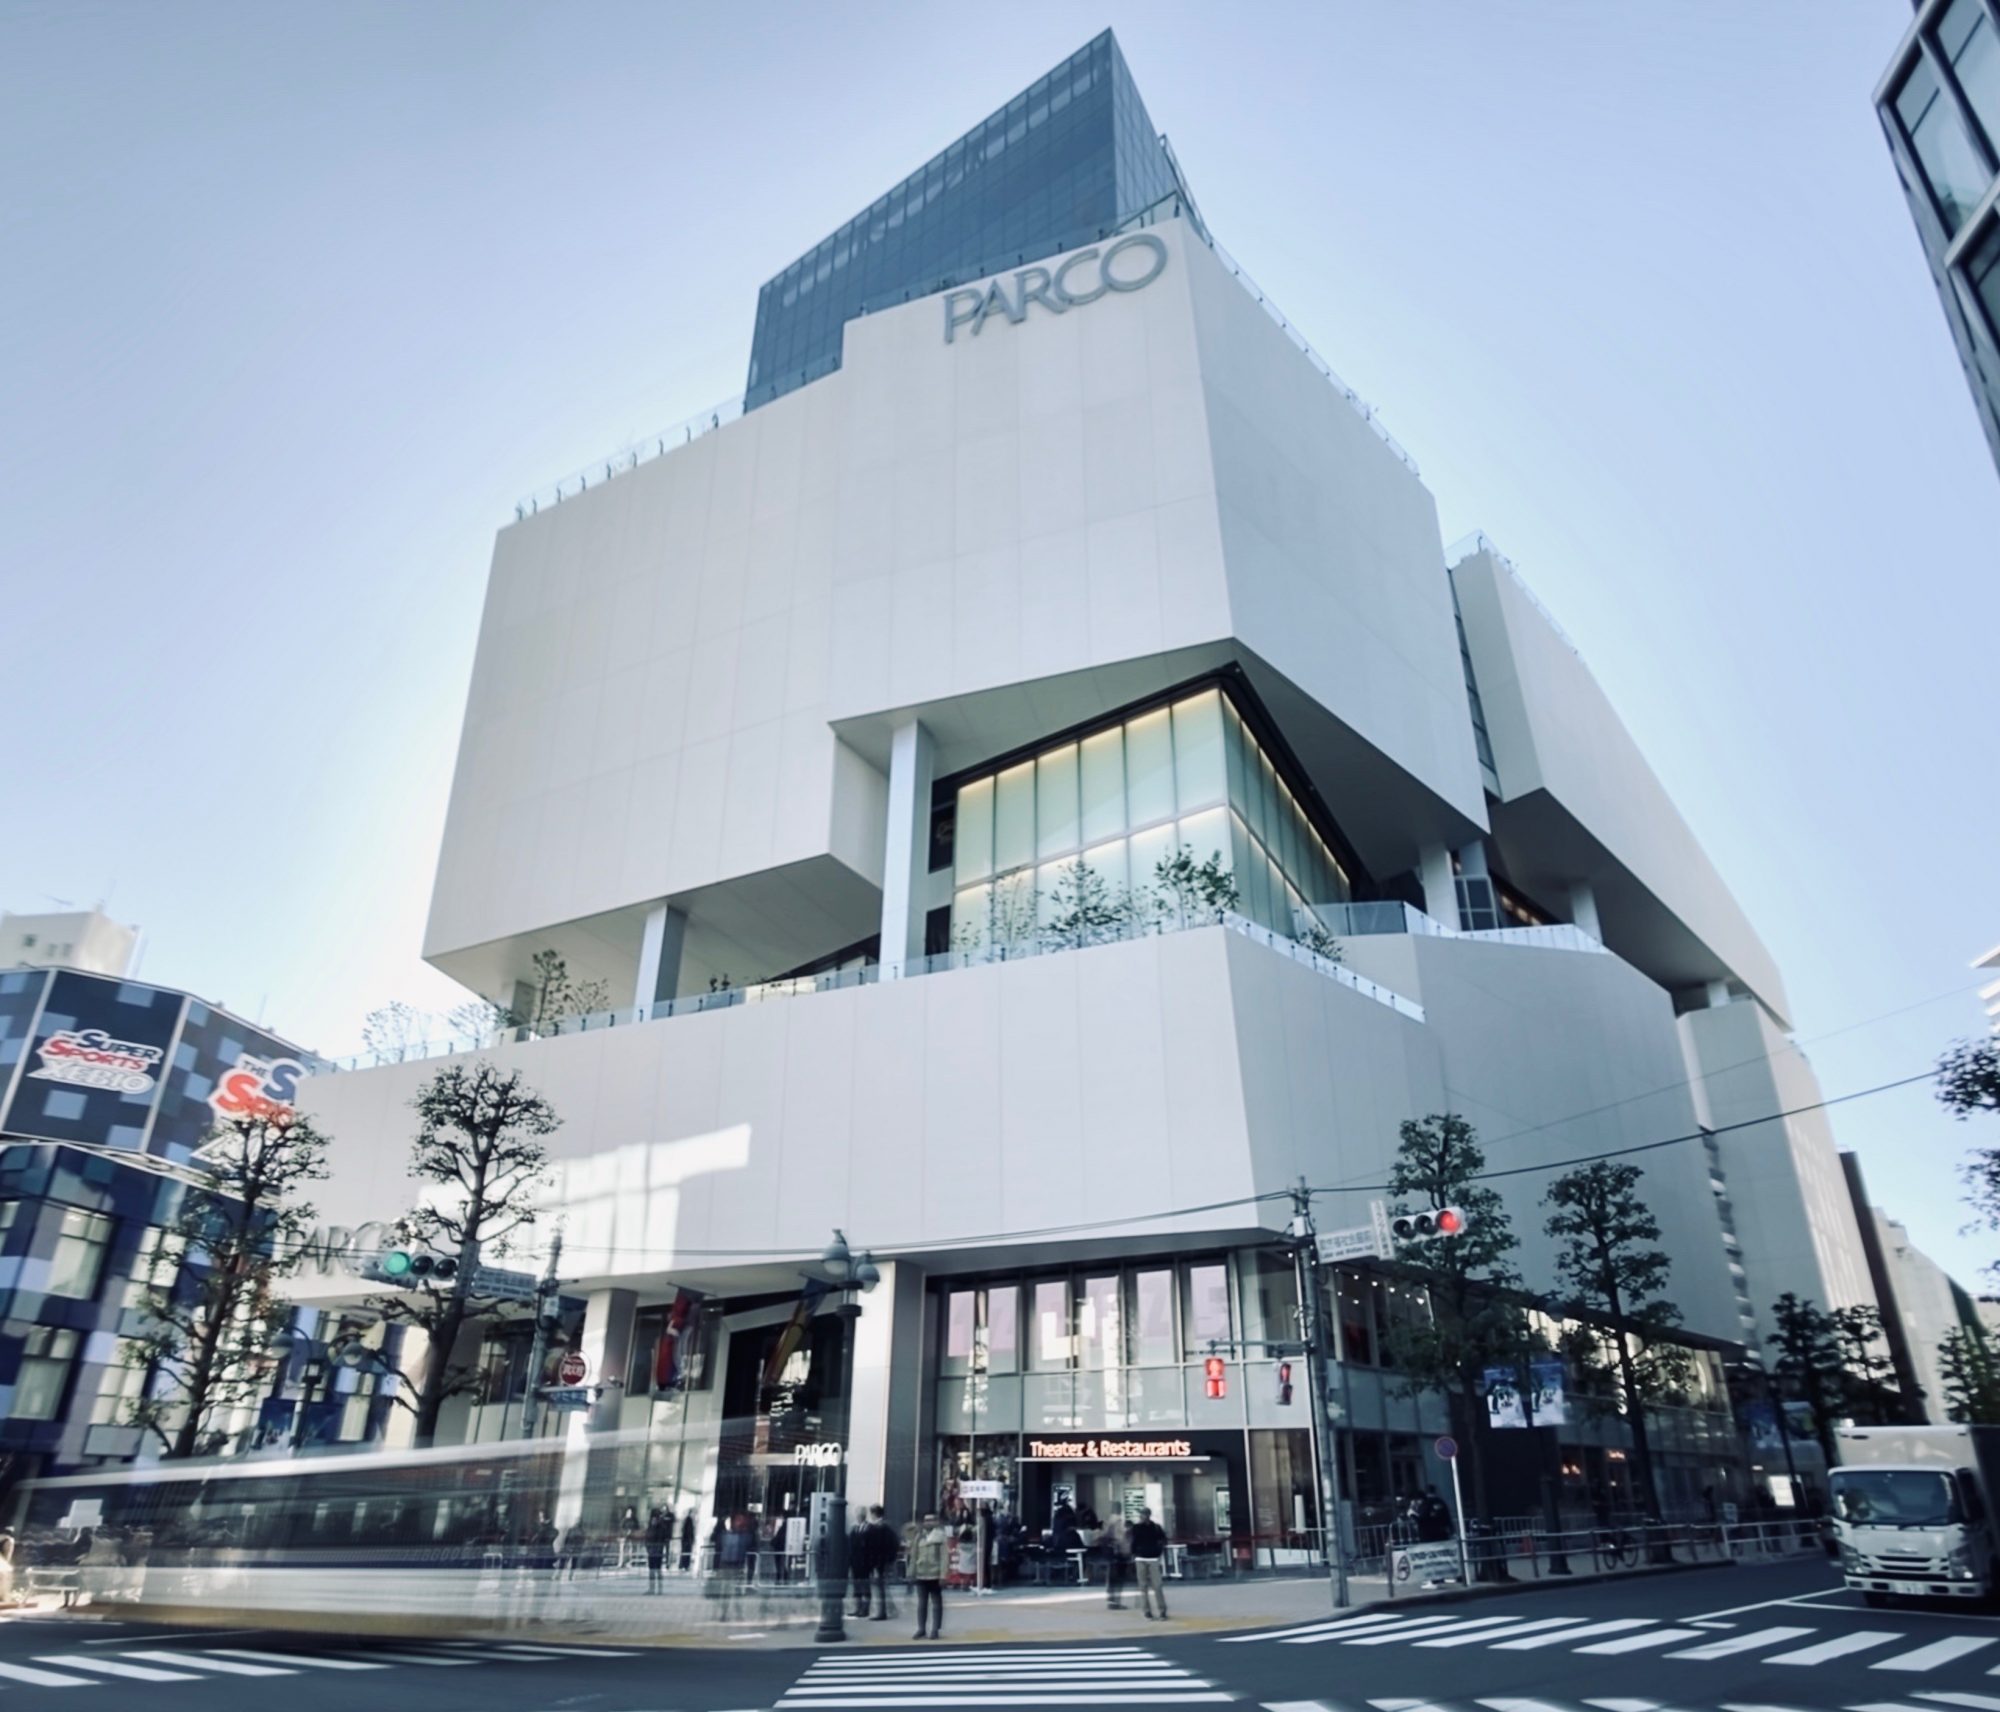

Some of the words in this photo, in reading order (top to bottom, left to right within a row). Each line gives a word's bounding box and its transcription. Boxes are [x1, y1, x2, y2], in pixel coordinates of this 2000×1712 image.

[943, 233, 1168, 344] PARCO
[43, 1039, 143, 1070] SPORTS
[76, 1031, 160, 1060] SUPER
[30, 1059, 154, 1093] XEBIO
[794, 1442, 842, 1467] PARCO
[1030, 1441, 1084, 1457] Theater
[1086, 1440, 1099, 1458] &
[1100, 1439, 1191, 1457] Restaurants
